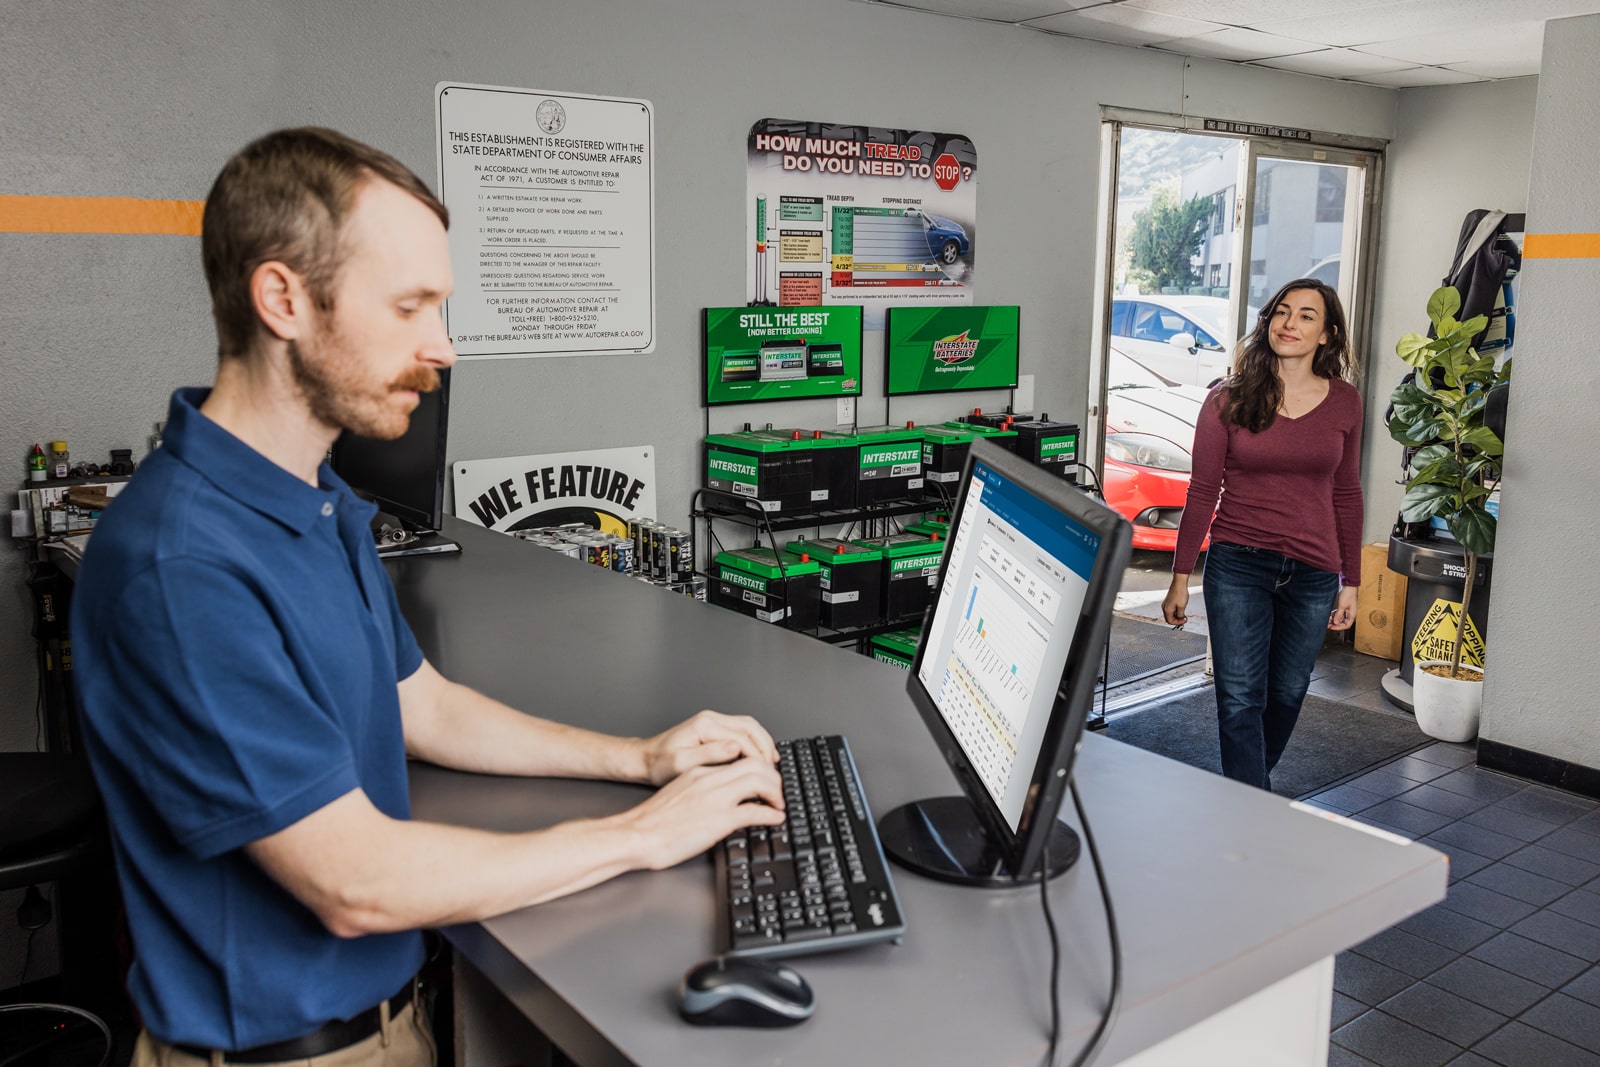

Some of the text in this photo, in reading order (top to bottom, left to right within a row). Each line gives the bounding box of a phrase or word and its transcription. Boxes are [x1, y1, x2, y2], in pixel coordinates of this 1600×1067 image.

[449, 132, 644, 153] THIS ESTABLISHMENT IS REGISTERED WITH THE
[757, 134, 921, 160] HOW MUCH TREAD
[452, 145, 642, 164] STATE DEPARTMENT OF CONSUMER AFFAIRS
[484, 166, 528, 174] ACCORDANCE
[783, 155, 972, 180] DO YOU NEED TO STOP ?
[740, 313, 830, 328] STILL THE BEST
[1042, 441, 1074, 450] INTERSTATE
[863, 450, 918, 464] INTERSTATE
[710, 459, 756, 476] INTERSTATE
[469, 464, 645, 529] WE FEATURE
[894, 556, 942, 570] INTERSTATE
[1444, 563, 1466, 572] SHOCK
[722, 571, 764, 591] INTERSTATE
[1449, 570, 1466, 578] STRU
[1414, 604, 1442, 647] STEERING
[1430, 637, 1455, 652] SAFET
[1456, 610, 1485, 664] SOPPING
[875, 653, 911, 671] INTERSTA
[1426, 647, 1466, 663] TRIANE
